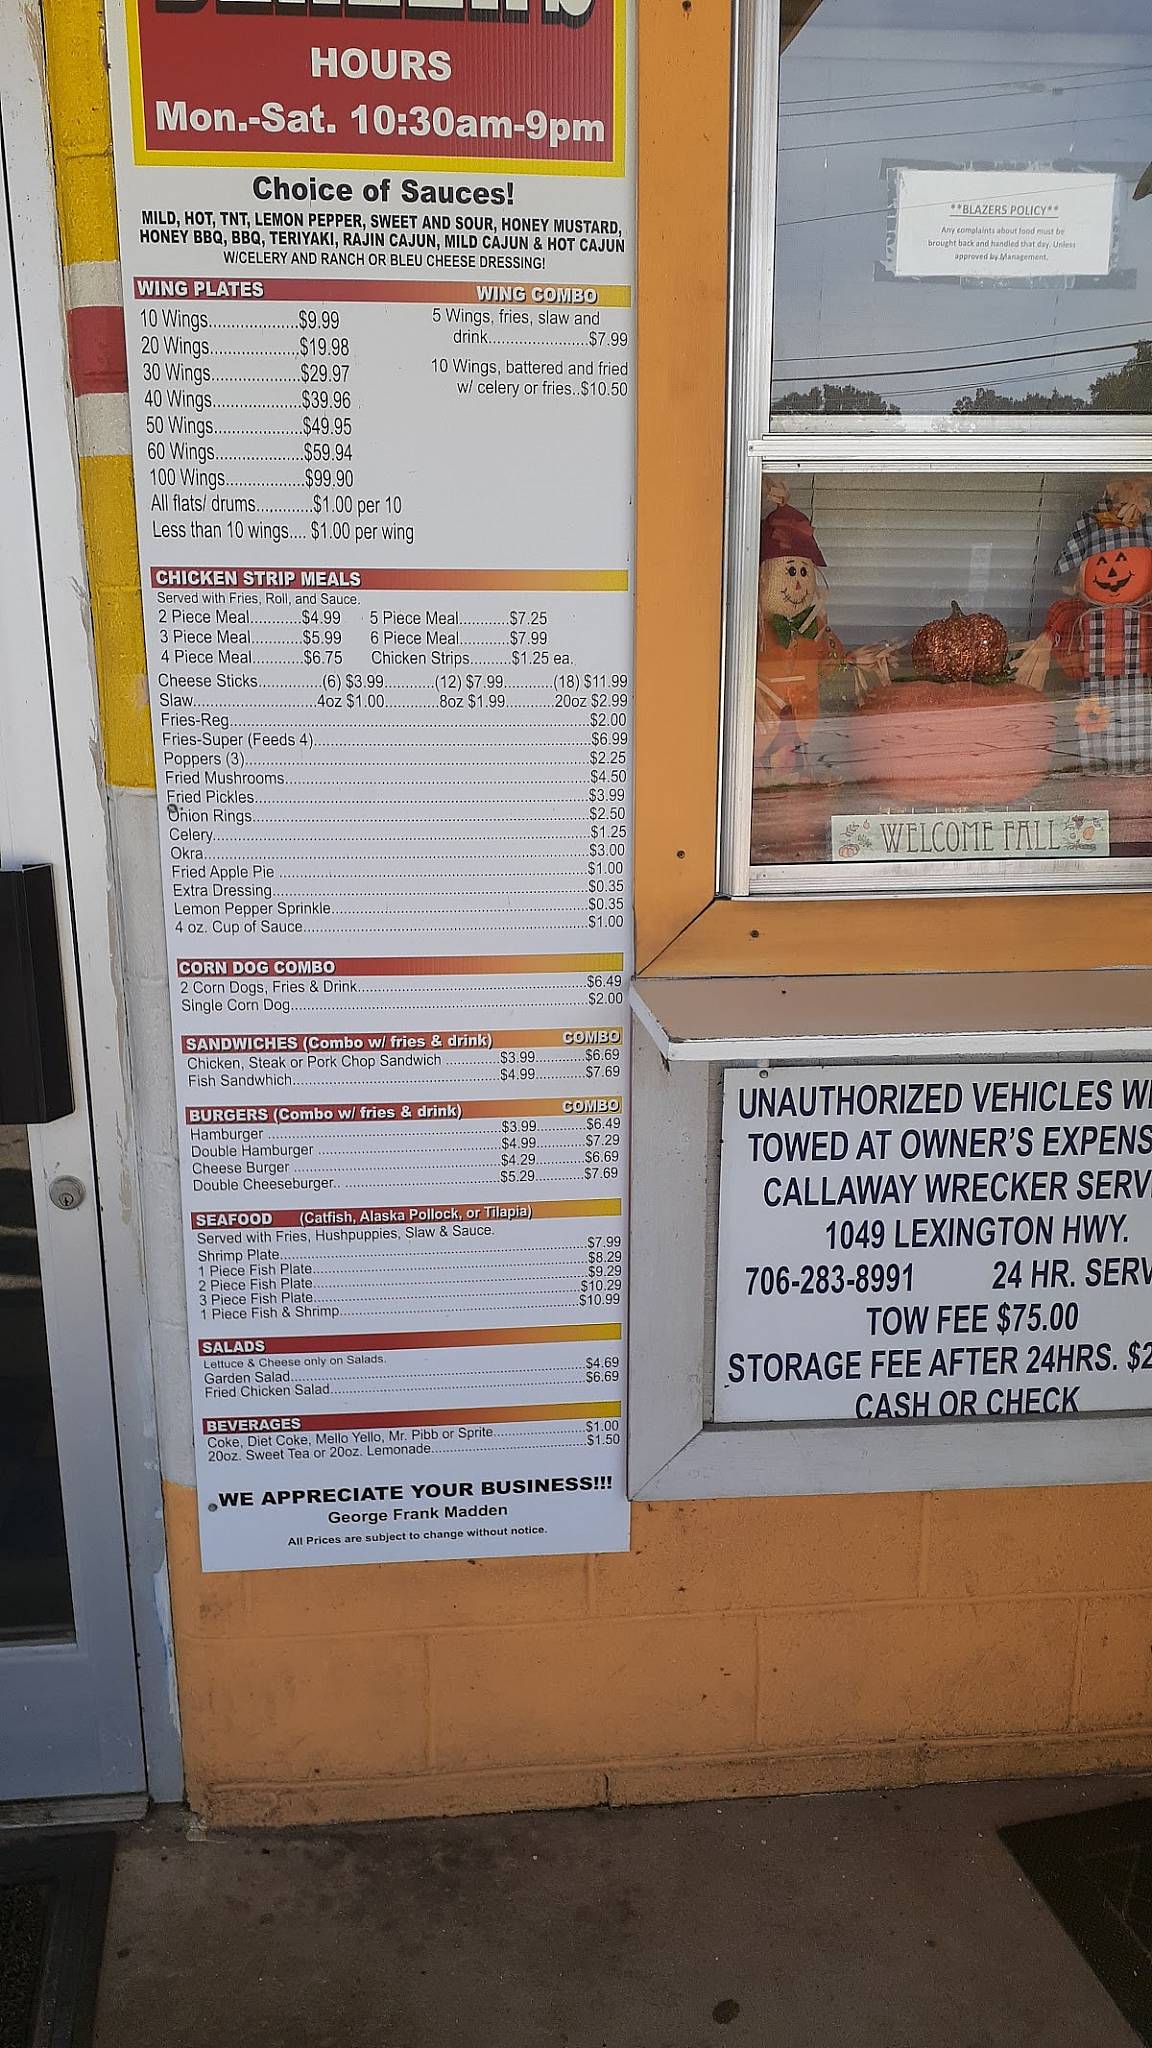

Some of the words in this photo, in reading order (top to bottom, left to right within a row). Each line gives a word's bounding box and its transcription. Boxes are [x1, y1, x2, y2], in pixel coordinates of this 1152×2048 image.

[311, 47, 452, 81] HOURS
[156, 101, 336, 134] Mon.-Sat.
[351, 105, 605, 148] 10:30am-9pm
[253, 176, 353, 201] Choice
[363, 178, 391, 202] of
[401, 179, 514, 205] Sauces!
[142, 210, 180, 228] MILD,
[184, 211, 216, 229] HOT,
[219, 211, 251, 229] TNT,
[255, 212, 304, 227] LEMON
[308, 213, 366, 231] PEPPER,
[370, 214, 418, 229] SWEET
[422, 215, 451, 230] AND
[455, 216, 497, 234] SOUR,
[501, 217, 550, 232] HONEY
[554, 219, 622, 238] MUSTARD,
[140, 229, 189, 243] HONEY
[193, 230, 227, 247] BBQ,
[231, 230, 265, 248] BBQ,
[269, 231, 339, 249] TERIYAKI,
[343, 232, 385, 247] RAJIN
[389, 233, 440, 251] CAJUN,
[444, 234, 478, 249] MILD
[482, 235, 528, 250] CAJUN
[533, 236, 543, 250] &
[548, 237, 576, 251] HOT
[579, 236, 625, 253] CAJUN
[223, 251, 288, 264] W/CELERY
[291, 252, 317, 265] AND
[321, 252, 365, 266] RANCH
[368, 253, 387, 266] OR
[390, 253, 423, 267] BLEU
[426, 254, 476, 268] CHEESE
[480, 255, 545, 269] DRESSING!
[137, 280, 188, 296] WING
[194, 281, 264, 297] PLATES
[475, 286, 526, 305] WING
[531, 287, 600, 304] COMBO
[299, 309, 340, 331] $9.99
[433, 308, 441, 323] 5
[445, 308, 494, 327] Wings,
[499, 308, 533, 327] fries,
[538, 310, 570, 325] slaw
[574, 311, 600, 326] and
[154, 570, 237, 588] CHICKEN
[243, 571, 295, 585] STRIP
[301, 571, 361, 586] MEALS
[157, 591, 199, 604] Served
[201, 592, 226, 604] with
[229, 592, 262, 606] Fries,
[266, 592, 291, 606] Roll,
[295, 593, 317, 605] and
[320, 593, 361, 605] Sauce.
[588, 788, 625, 803] $3.99
[880, 821, 995, 853] WELCOME
[1003, 819, 1061, 851] FALL
[179, 961, 227, 974] CORN
[232, 961, 269, 974] DOG
[274, 960, 335, 974] COMBO
[186, 1036, 298, 1051] SANDWICHES
[303, 1036, 363, 1052] (Combo
[368, 1035, 386, 1048] w/
[390, 1035, 426, 1048] fries
[431, 1034, 442, 1047] &
[448, 1033, 495, 1050] drink)
[562, 1030, 622, 1046] COMBO
[562, 1099, 622, 1114] COMBO
[739, 1083, 963, 1119] UNAUTHORIZED
[972, 1080, 1113, 1112] VEHICLES
[190, 1108, 268, 1122] BURGERS
[273, 1107, 333, 1122] (Combo
[338, 1107, 356, 1119] w/
[360, 1106, 395, 1119] fries
[400, 1105, 412, 1118] &
[417, 1104, 462, 1119] drink)
[748, 1131, 849, 1163] TOWED
[856, 1130, 892, 1160] AT
[901, 1127, 1034, 1159] OWNER'S
[764, 1174, 918, 1207] CALLAWAY
[925, 1171, 1068, 1203] WRECKER
[1076, 1169, 1152, 1200] SERV
[196, 1211, 273, 1226] SEAFOOD
[300, 1210, 356, 1226] (Catfish,
[360, 1209, 405, 1222] Alaska
[409, 1207, 462, 1221] Pollock,
[466, 1209, 481, 1218] or
[483, 1205, 535, 1221] Tilapia)
[197, 1231, 242, 1245] Served
[246, 1231, 272, 1243] with
[276, 1230, 311, 1243] Fries,
[316, 1227, 401, 1242] Hushpuppies,
[405, 1226, 436, 1239] Slaw
[439, 1225, 449, 1237] &
[452, 1224, 495, 1237] Sauce.
[826, 1220, 885, 1249] 1049
[895, 1216, 1054, 1248] LEXINGTON
[1063, 1214, 1128, 1244] HWY.
[745, 1263, 913, 1295] 706-283-8991
[992, 1260, 1022, 1289] 24
[1031, 1259, 1075, 1288] HR.
[866, 1306, 929, 1336] TOW
[937, 1304, 989, 1334] FEE
[996, 1301, 1079, 1334] $75.00
[202, 1340, 265, 1353] SALADS
[728, 1351, 862, 1383] STORAGE
[871, 1349, 922, 1378] FEE
[928, 1346, 1018, 1377] AFTER
[1026, 1343, 1118, 1374] 24HRS.
[855, 1391, 930, 1418] CASH
[939, 1390, 977, 1415] OR
[987, 1386, 1081, 1414] CHECK
[206, 1417, 302, 1432] BEVERAGES
[218, 1492, 254, 1507] WE
[261, 1485, 403, 1505] APPRECIATE
[410, 1483, 474, 1498] YOUR
[481, 1476, 612, 1495] BUSINESS!!!
[328, 1511, 388, 1525] George
[393, 1507, 439, 1520] Frank
[444, 1504, 508, 1518] Madden
[288, 1537, 303, 1546] All
[306, 1536, 341, 1545] Prices
[365, 1532, 406, 1543] subject
[409, 1532, 420, 1540] to
[423, 1530, 464, 1540] change
[466, 1528, 508, 1537] without
[511, 1526, 548, 1535] notice.
